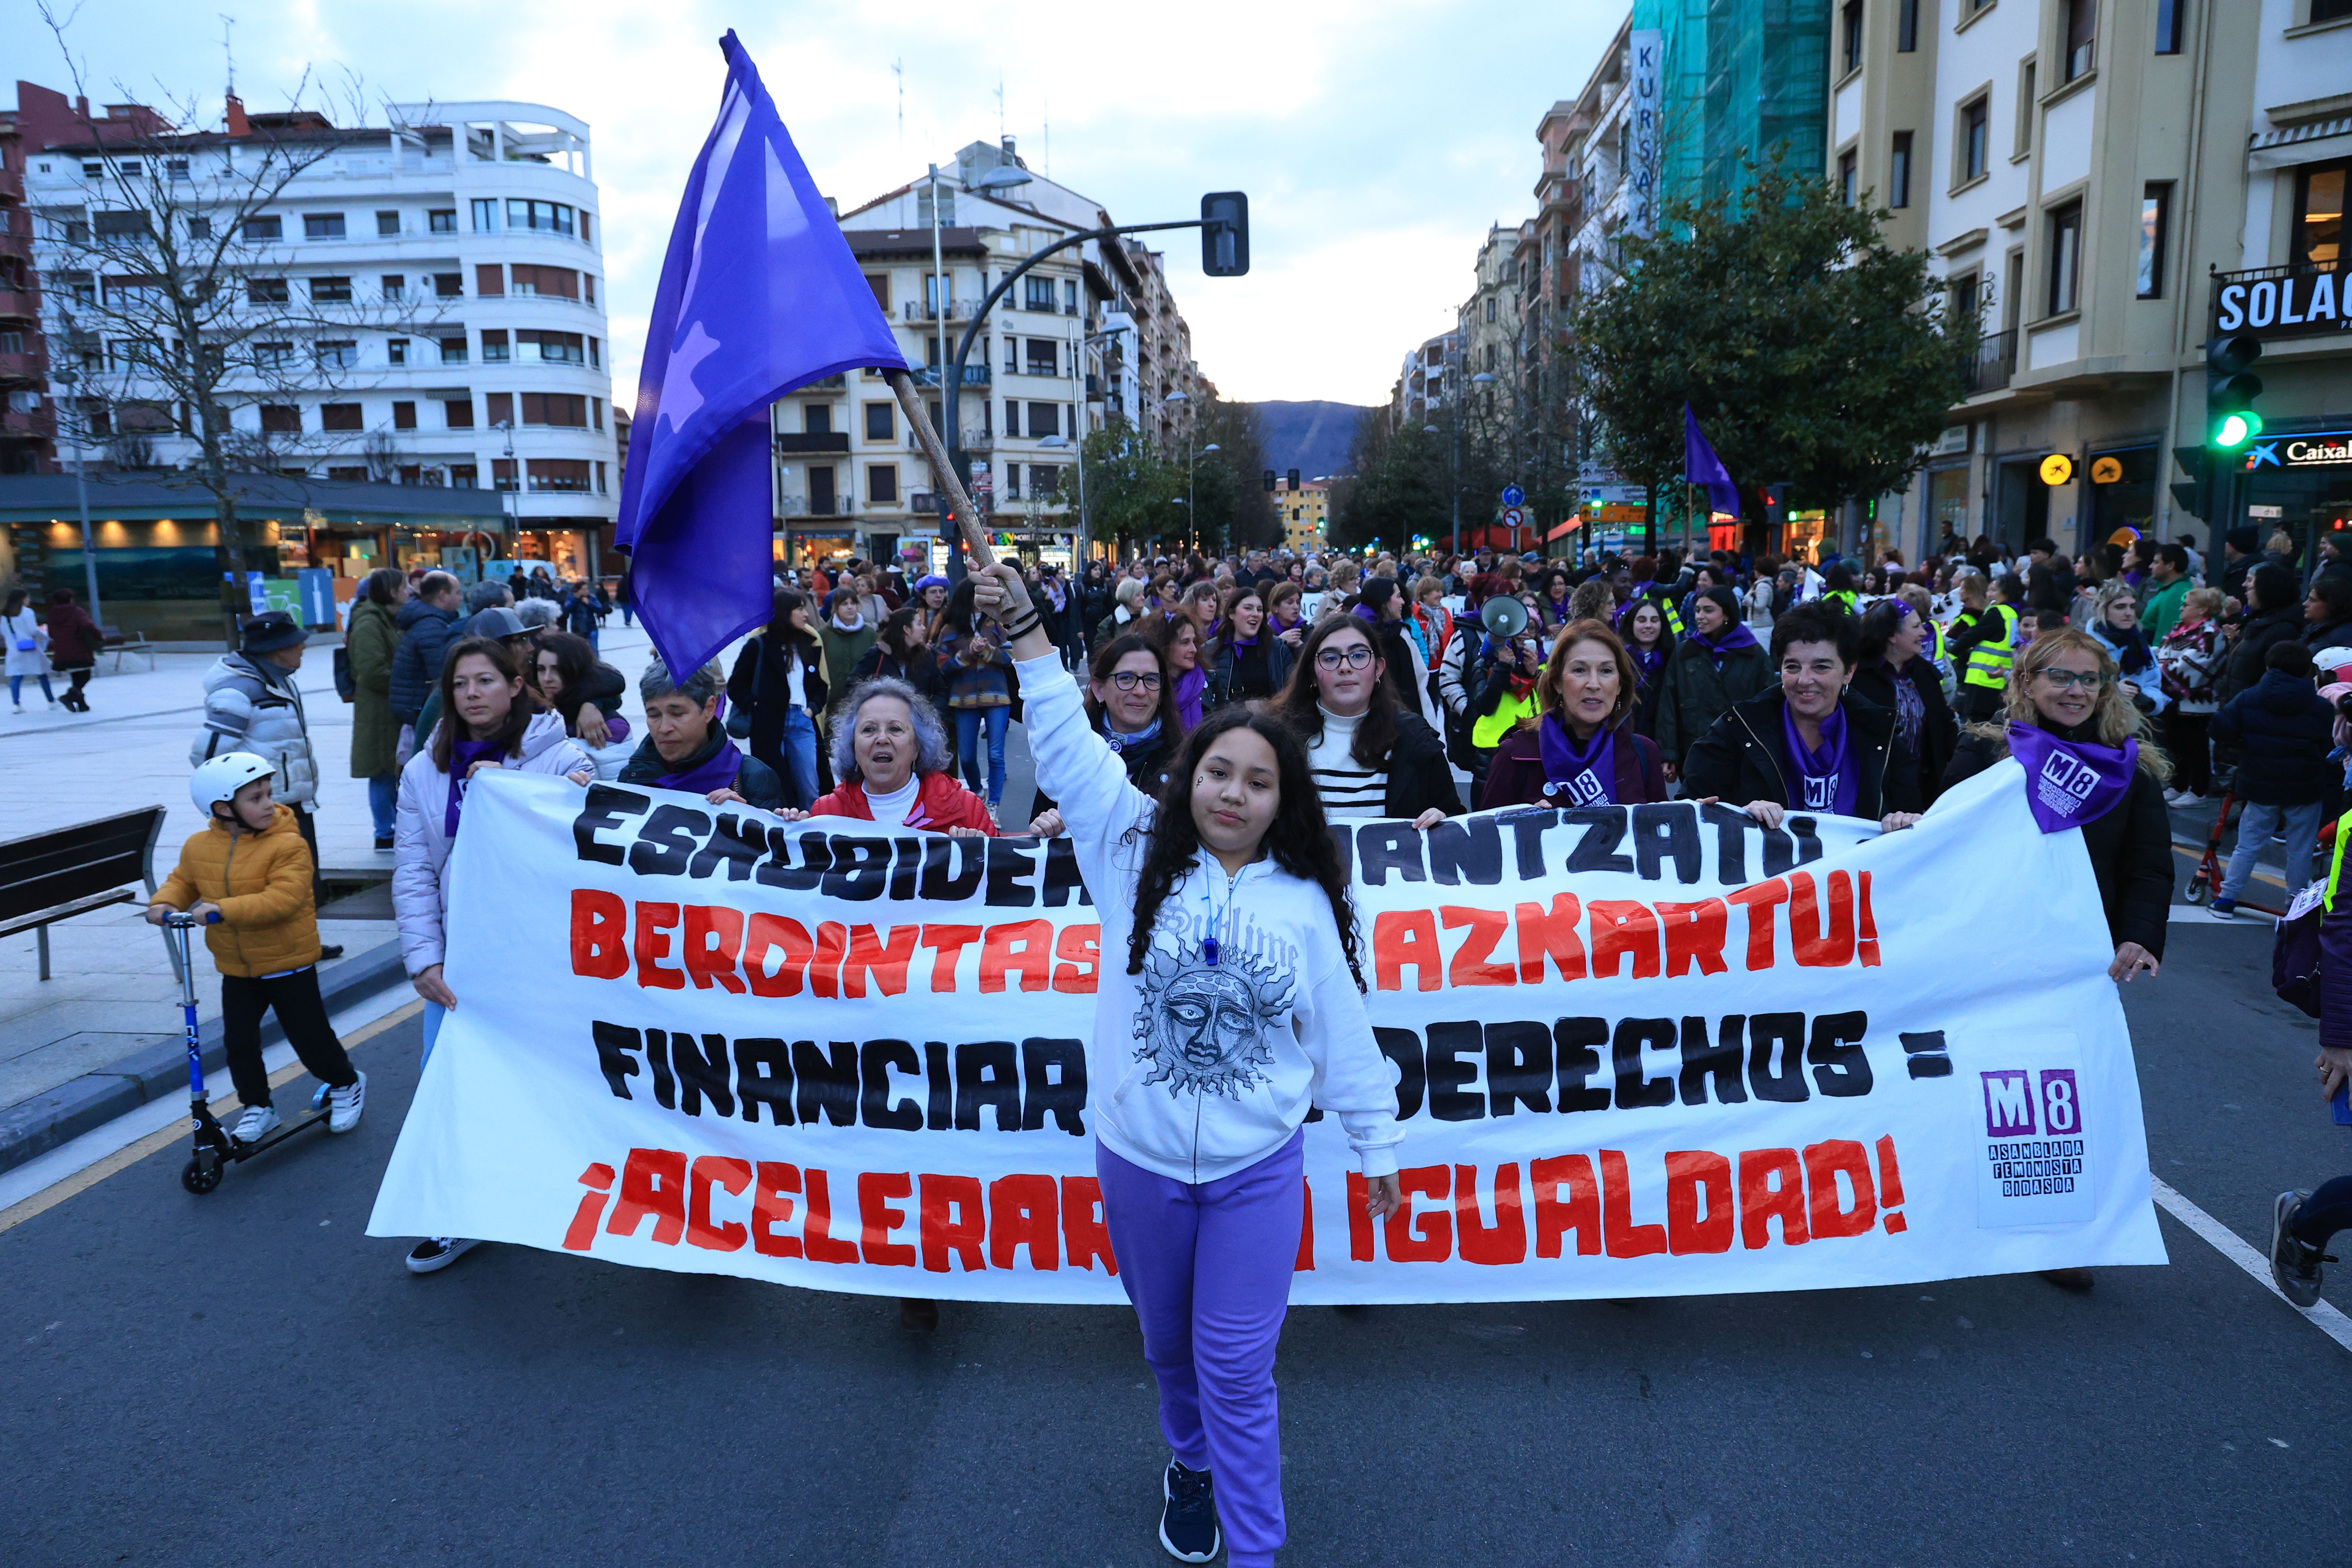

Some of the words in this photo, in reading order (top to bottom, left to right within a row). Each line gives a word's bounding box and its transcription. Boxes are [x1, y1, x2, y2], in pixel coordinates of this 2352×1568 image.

[1637, 46, 1653, 221] KURSAA
[2045, 753, 2095, 796] M8
[1373, 869, 1881, 991] AZKARTU!
[592, 1020, 1087, 1136] FINANCIAR
[1371, 1011, 1874, 1122] DERECHOS
[1985, 1074, 2076, 1132] M8
[1989, 1140, 2083, 1160] ASANBLADA
[1994, 1158, 2082, 1178] FEMINISTA
[562, 1148, 1119, 1276] ¡ACELERAR
[1346, 1133, 1907, 1265] IGUALDAD!
[2003, 1177, 2074, 1197] BIDASOA
